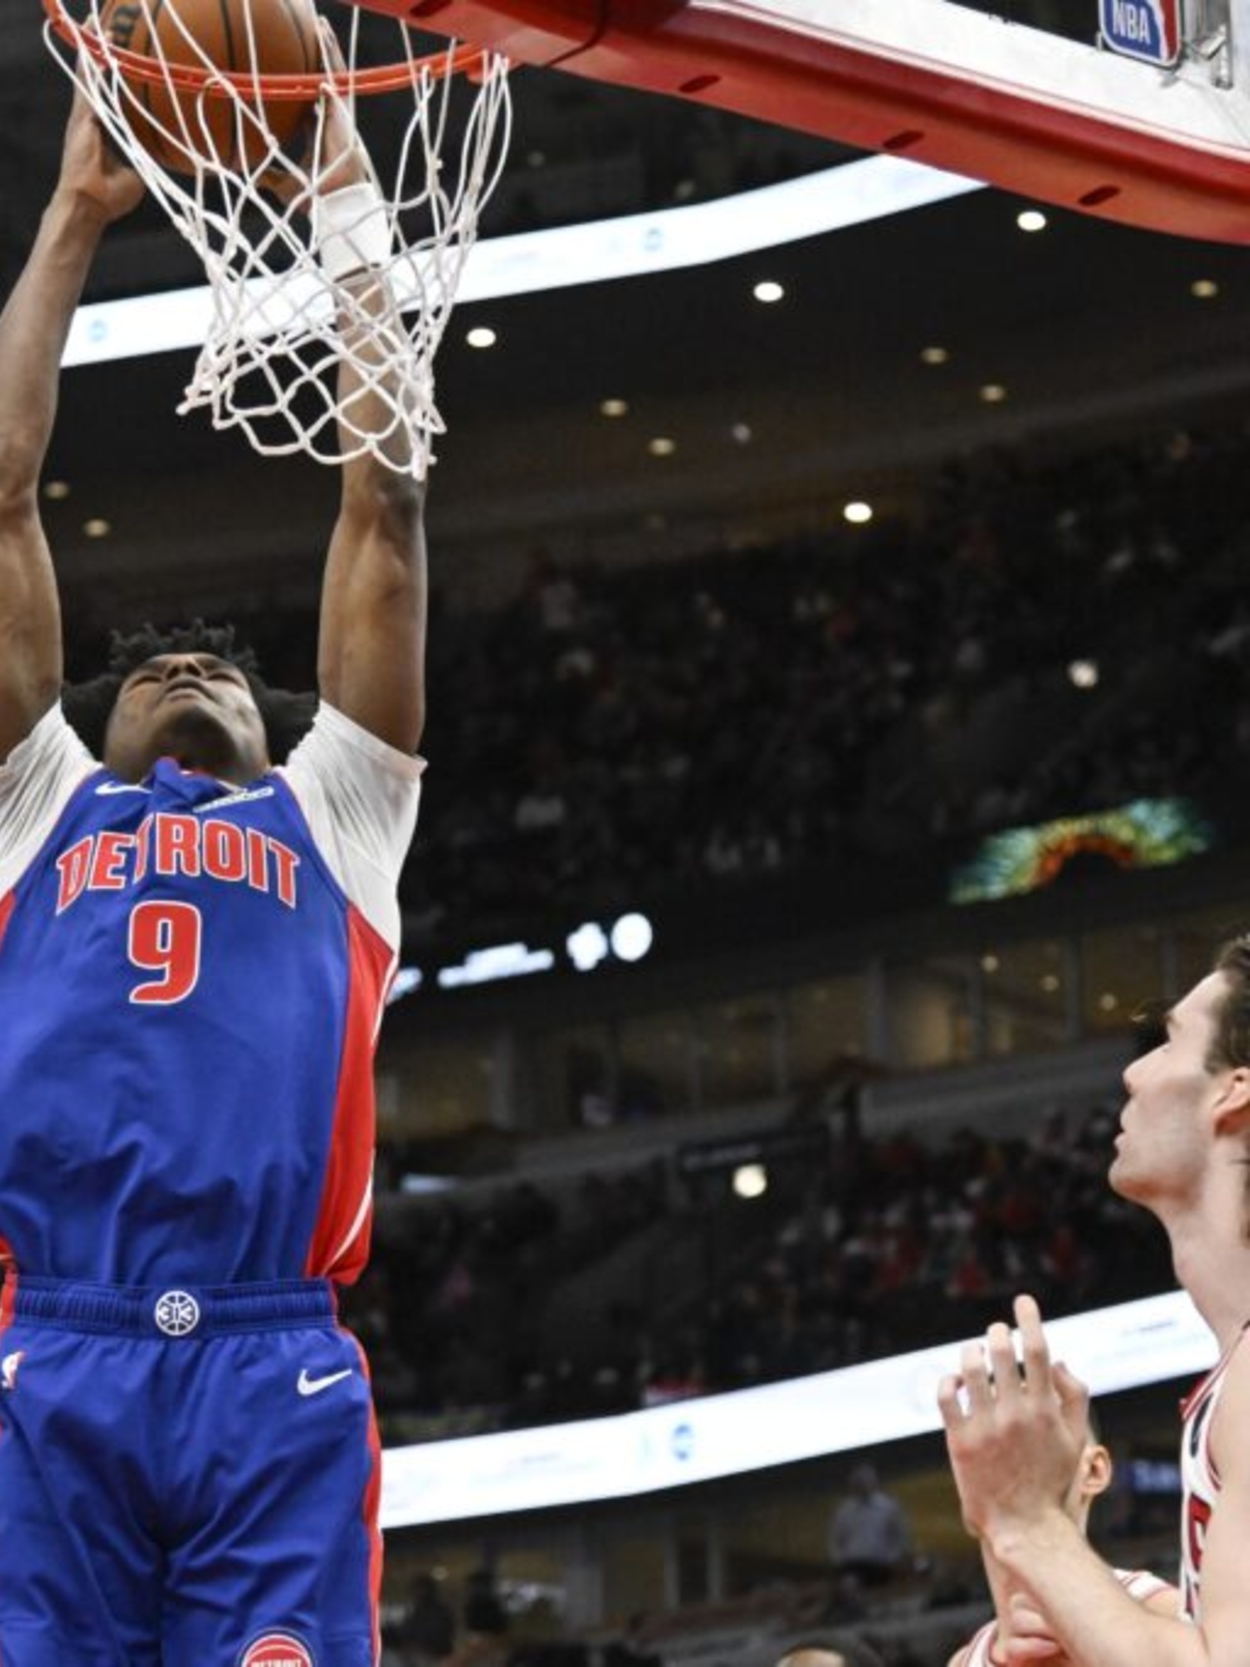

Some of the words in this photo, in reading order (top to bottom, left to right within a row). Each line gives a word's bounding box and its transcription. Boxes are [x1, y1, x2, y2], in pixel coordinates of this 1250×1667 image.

[1112, 0, 1151, 45] NBA
[56, 812, 301, 916] DETROIT
[128, 900, 202, 1004] 9
